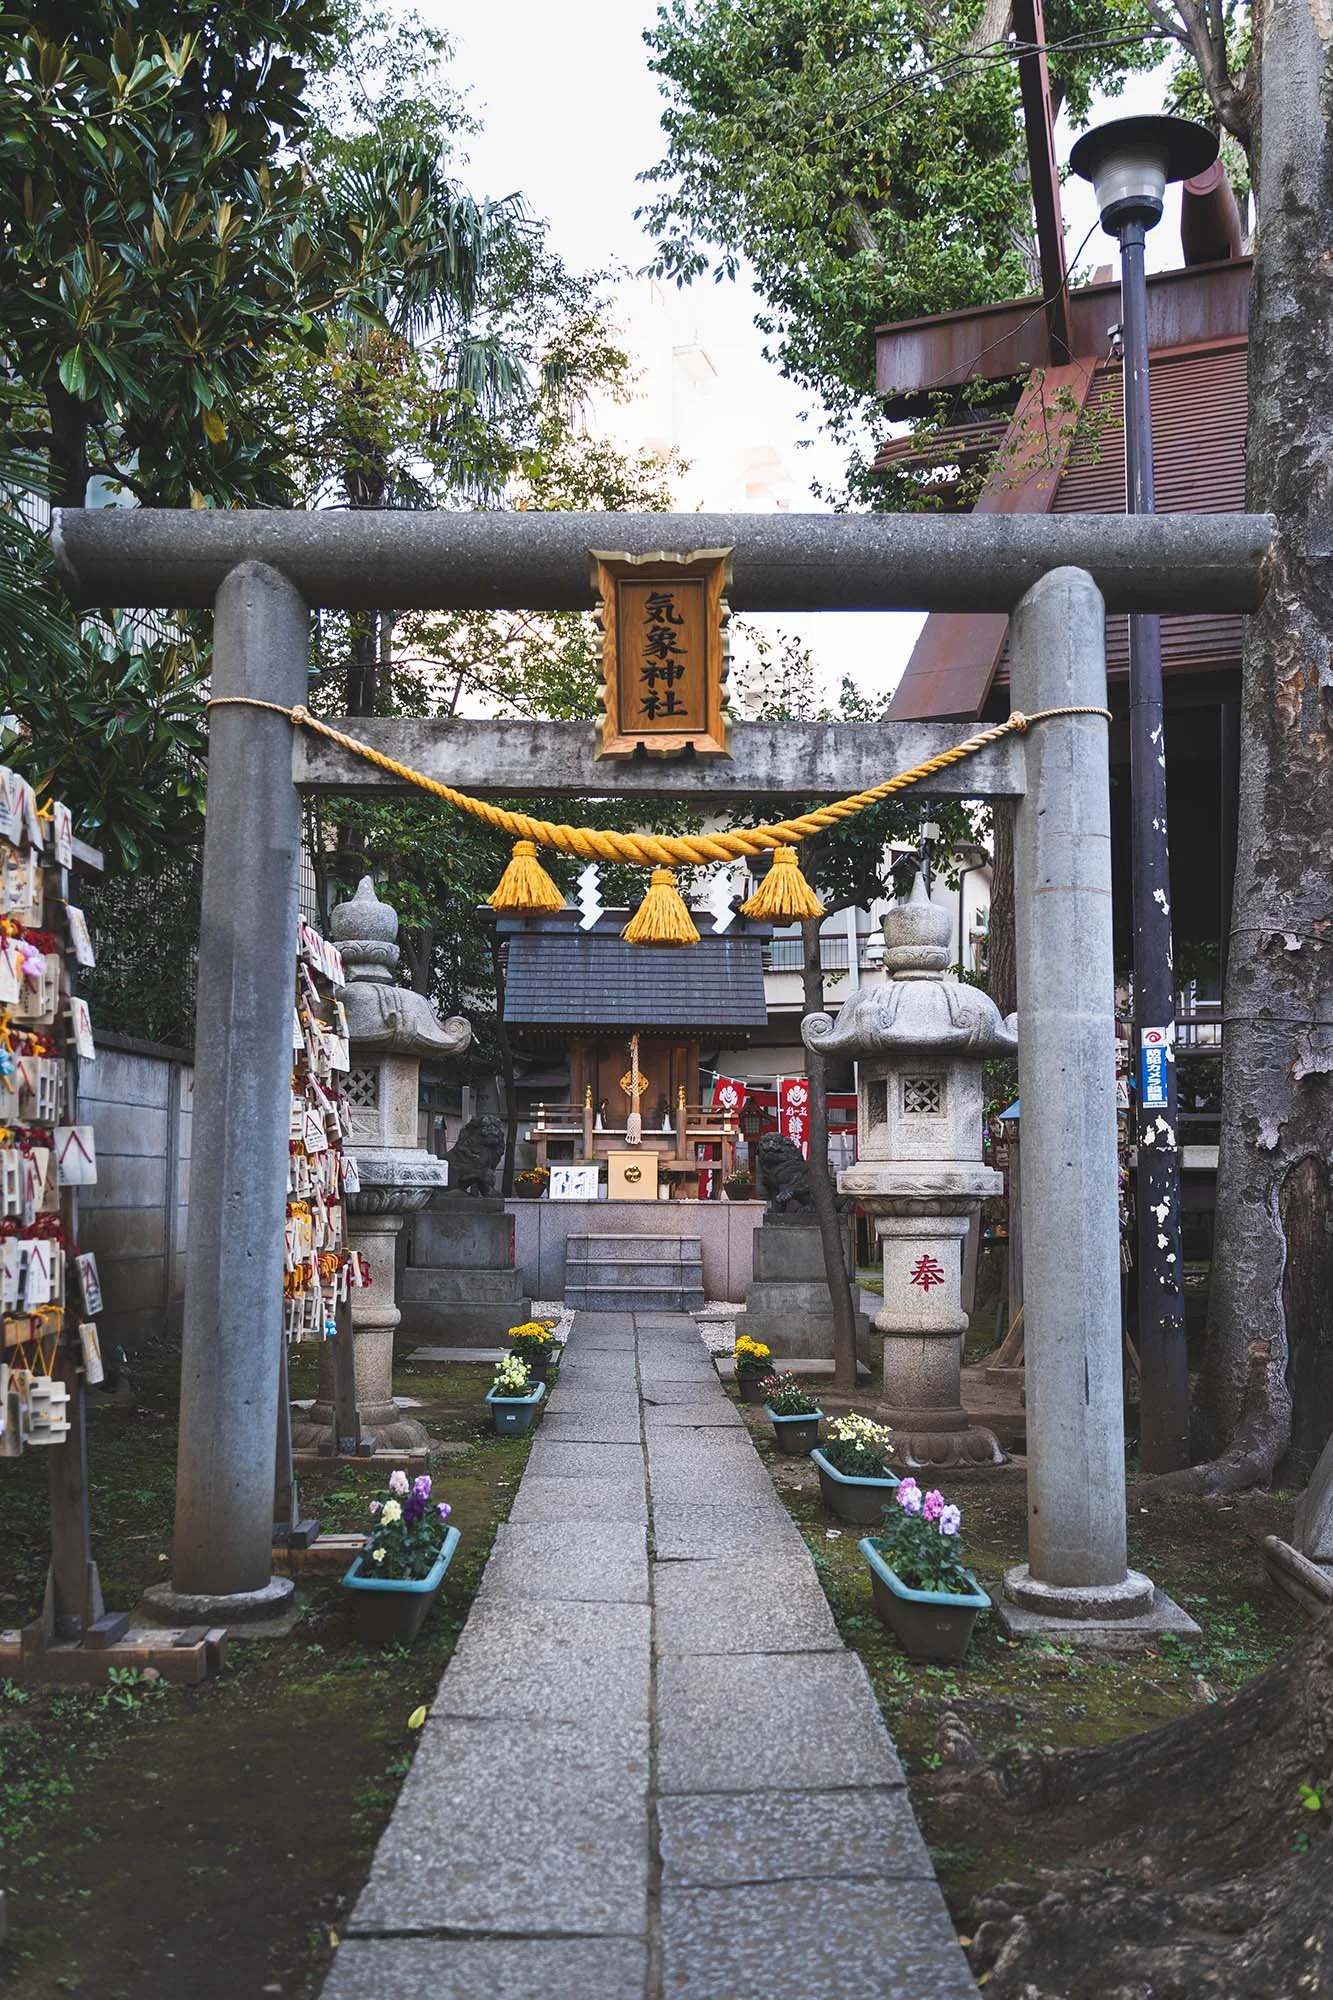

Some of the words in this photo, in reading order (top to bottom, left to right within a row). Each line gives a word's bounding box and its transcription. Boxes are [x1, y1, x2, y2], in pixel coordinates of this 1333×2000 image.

[638, 591, 689, 721] 気象神社
[1146, 1048, 1163, 1101] 防犯カメラ設置
[909, 1254, 945, 1293] 奉
